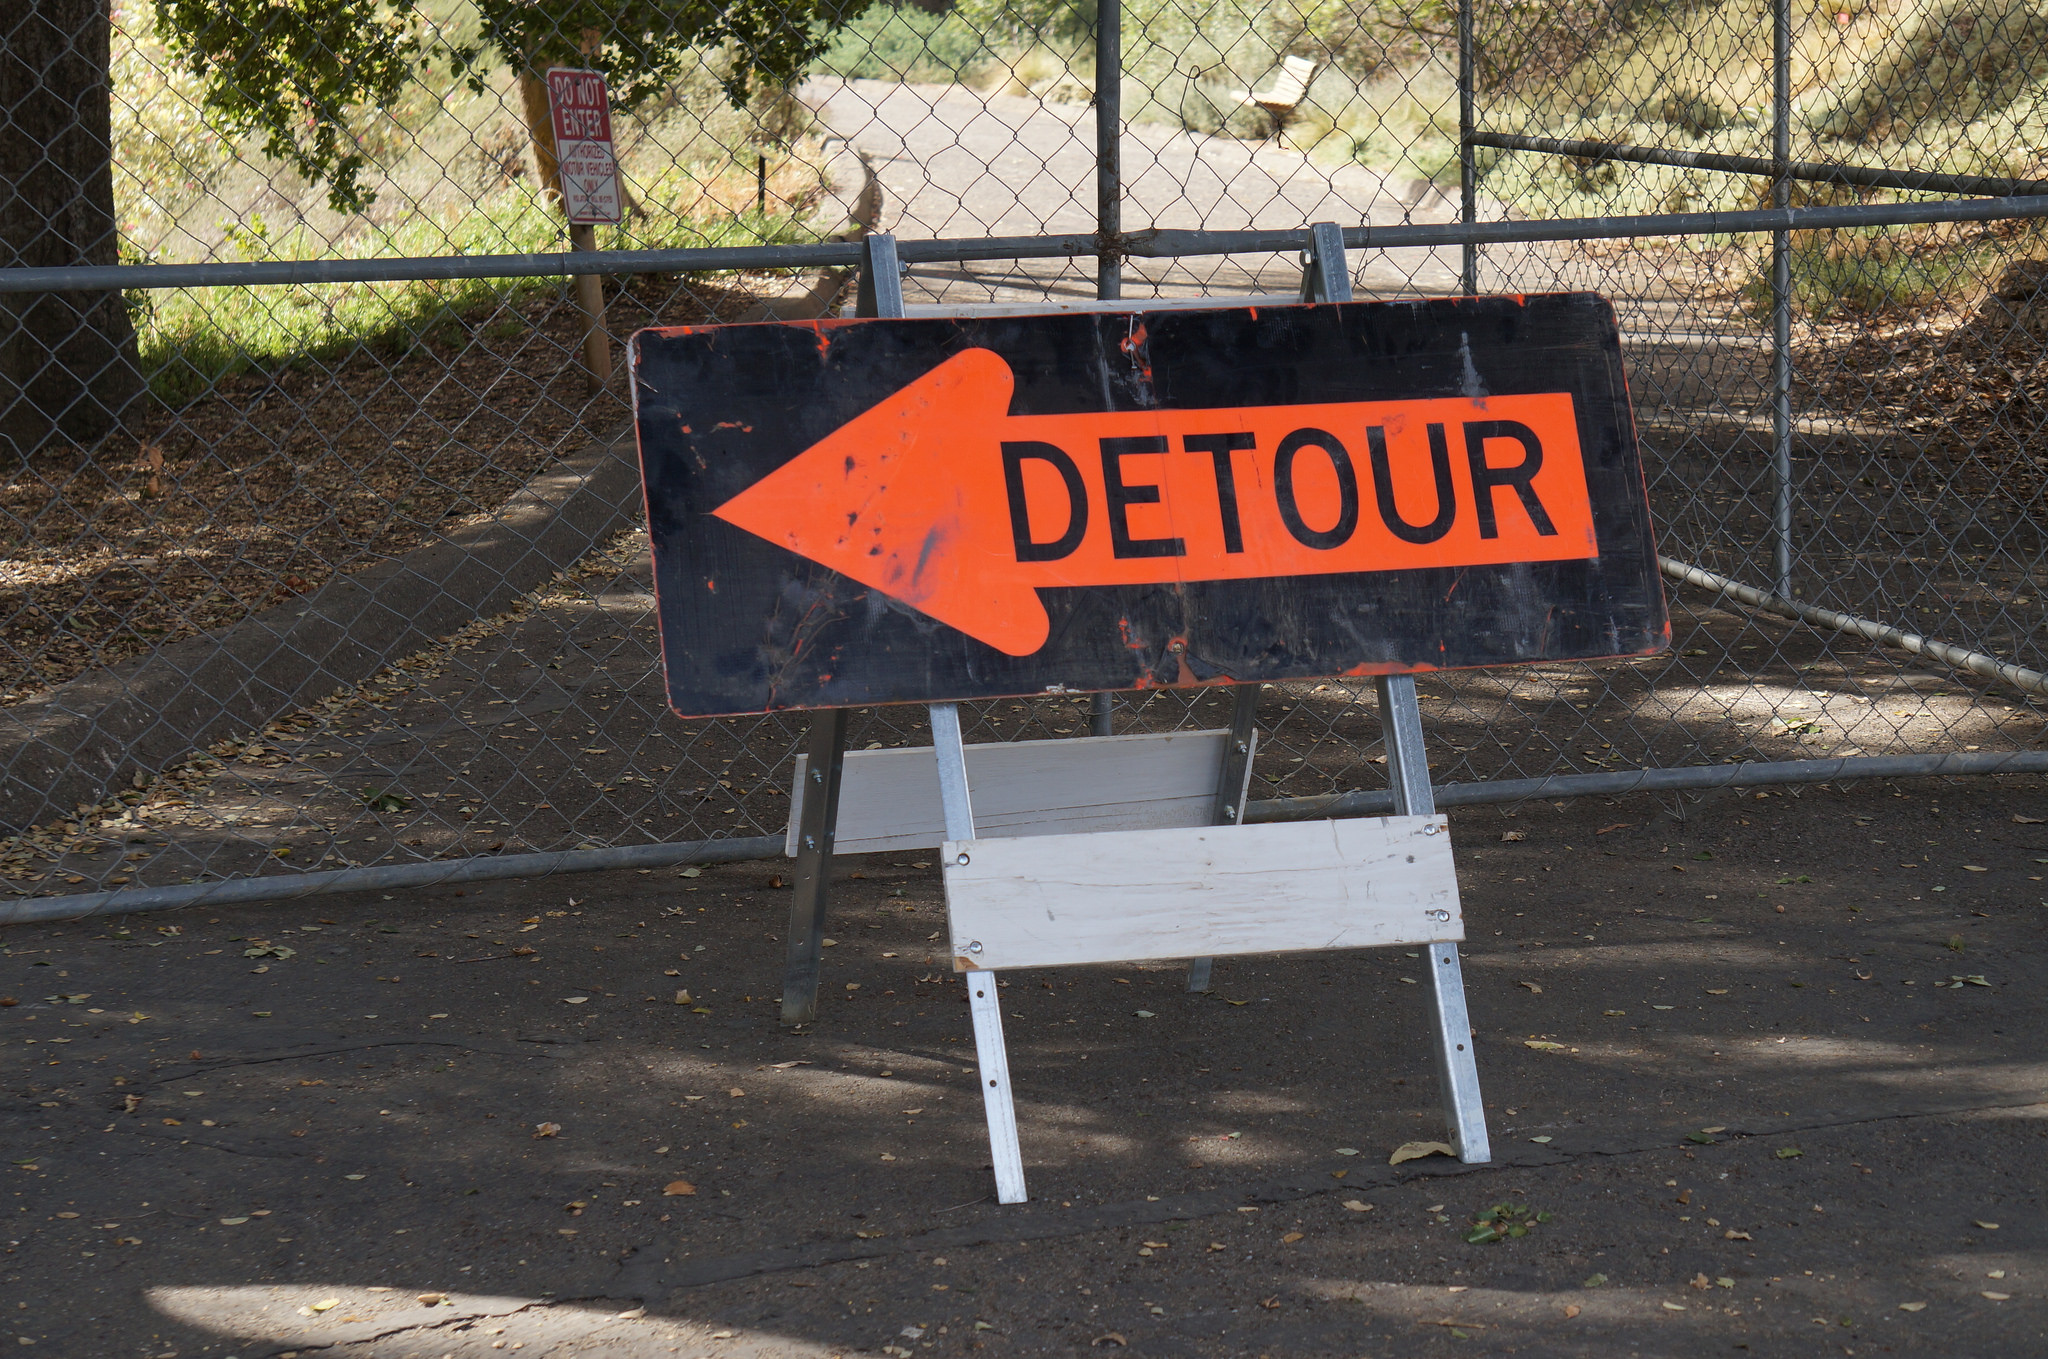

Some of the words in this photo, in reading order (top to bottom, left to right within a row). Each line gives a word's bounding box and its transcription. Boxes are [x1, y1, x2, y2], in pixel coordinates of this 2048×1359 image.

[554, 76, 574, 106] DO
[577, 78, 600, 107] NOT
[562, 109, 602, 137] ENTER
[586, 161, 613, 177] VEHICLES
[1000, 418, 1559, 563] DETOUR
